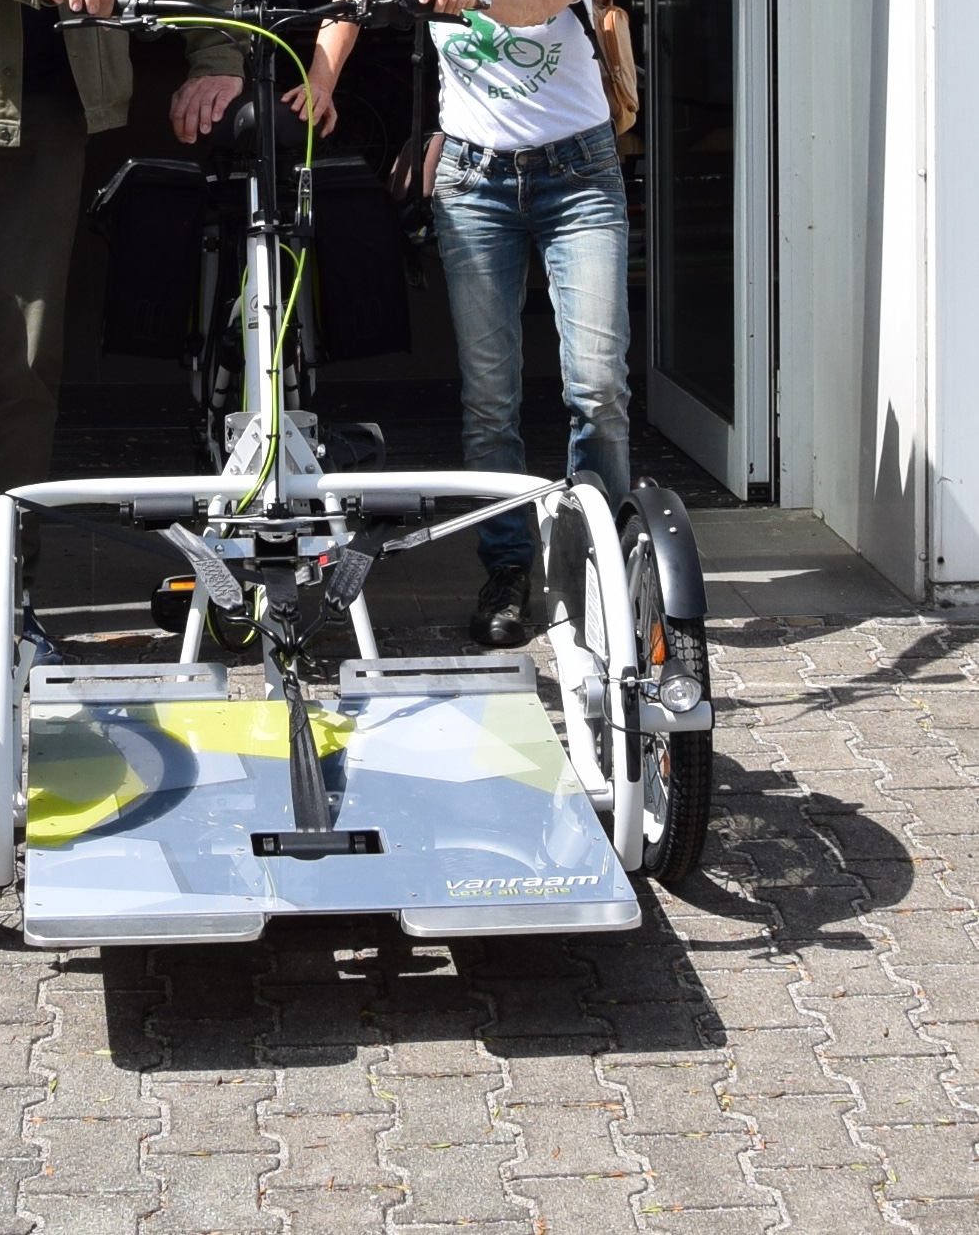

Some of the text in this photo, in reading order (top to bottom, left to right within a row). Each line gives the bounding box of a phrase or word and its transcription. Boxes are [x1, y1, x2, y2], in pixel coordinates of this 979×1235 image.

[487, 42, 563, 100] BENÜTZEN
[445, 874, 601, 890] vanraam
[498, 886, 521, 897] all
